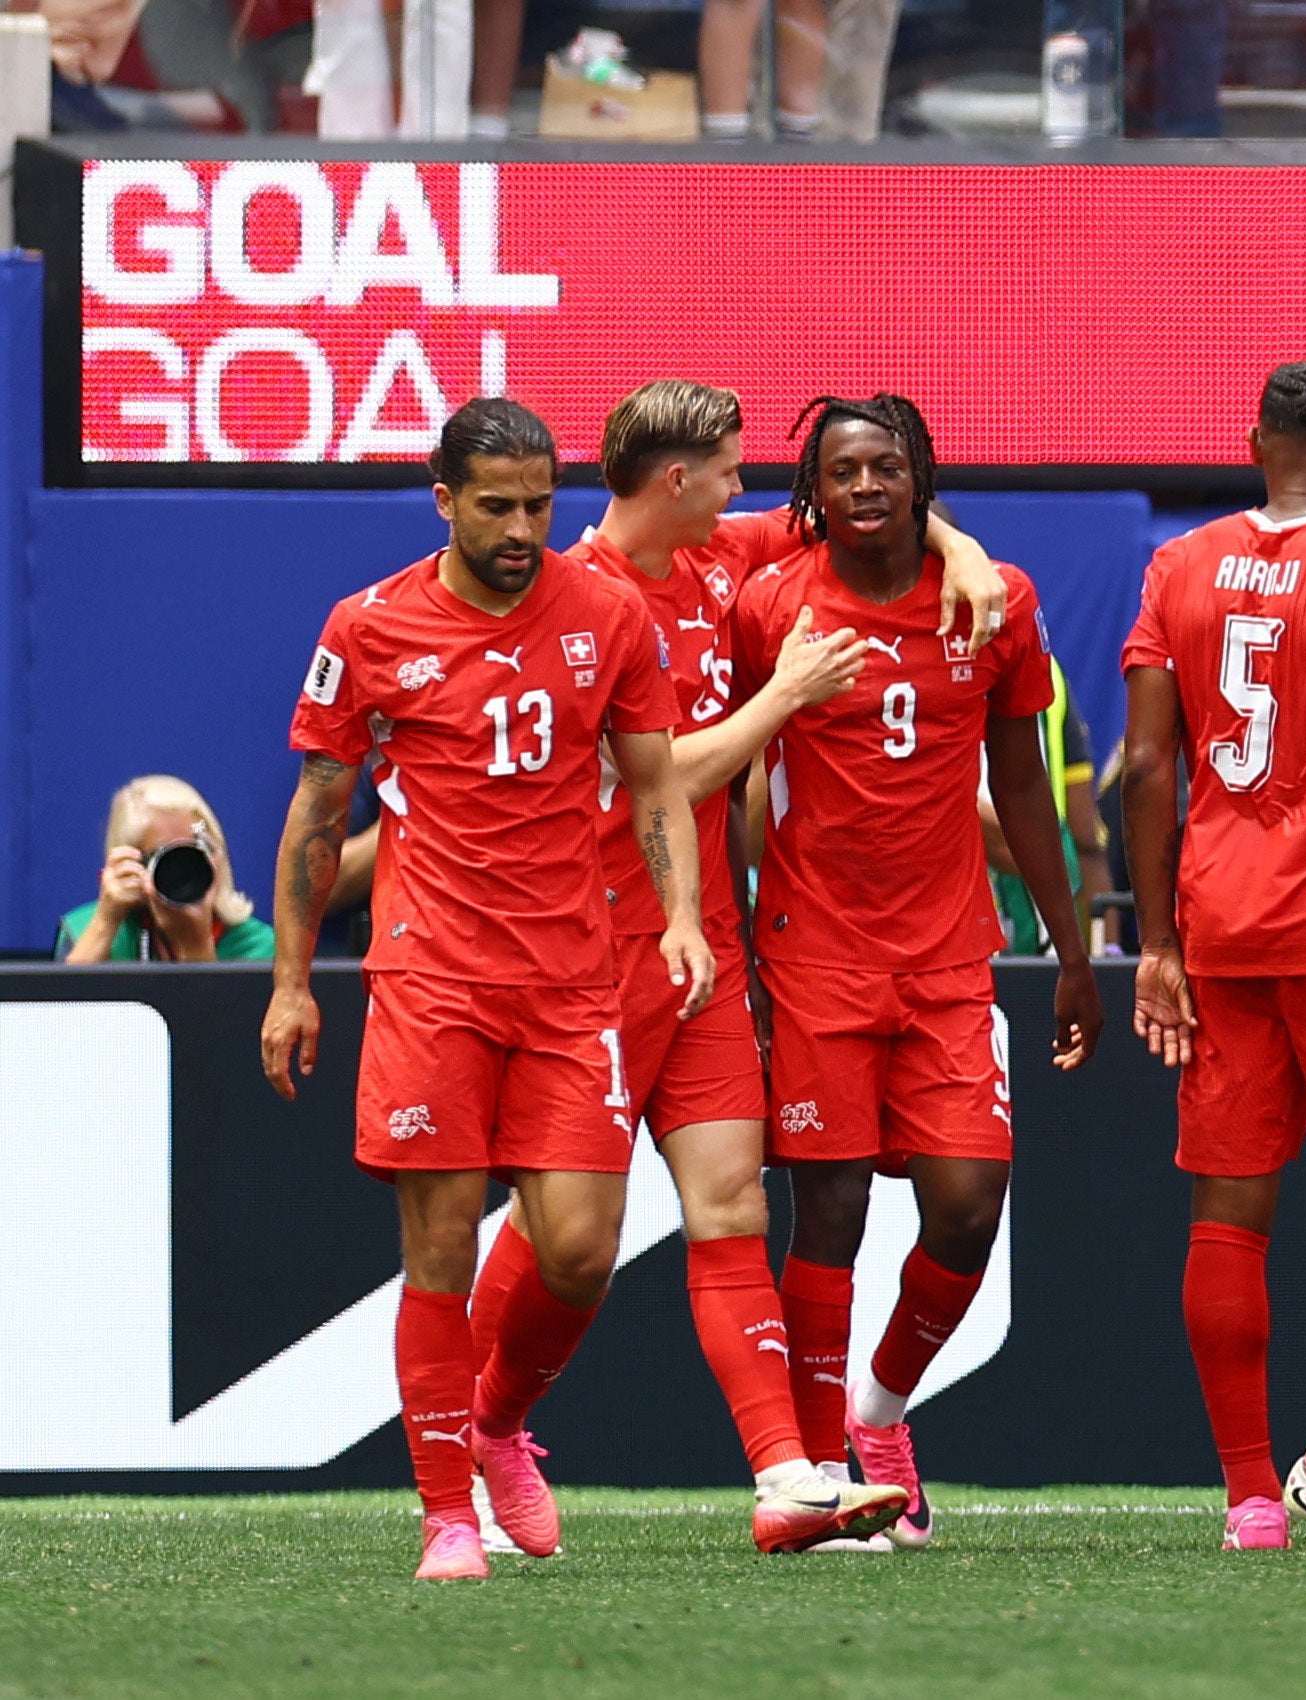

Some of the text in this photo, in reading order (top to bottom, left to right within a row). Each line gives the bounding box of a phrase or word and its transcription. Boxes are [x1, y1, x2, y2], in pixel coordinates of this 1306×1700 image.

[82, 160, 563, 308] GOAL
[1215, 555, 1301, 596] AKANJI
[482, 689, 553, 777] 13
[882, 682, 917, 759] 9
[1209, 614, 1285, 793] 5
[599, 1028, 629, 1108] 1
[411, 1408, 469, 1423] suisse
